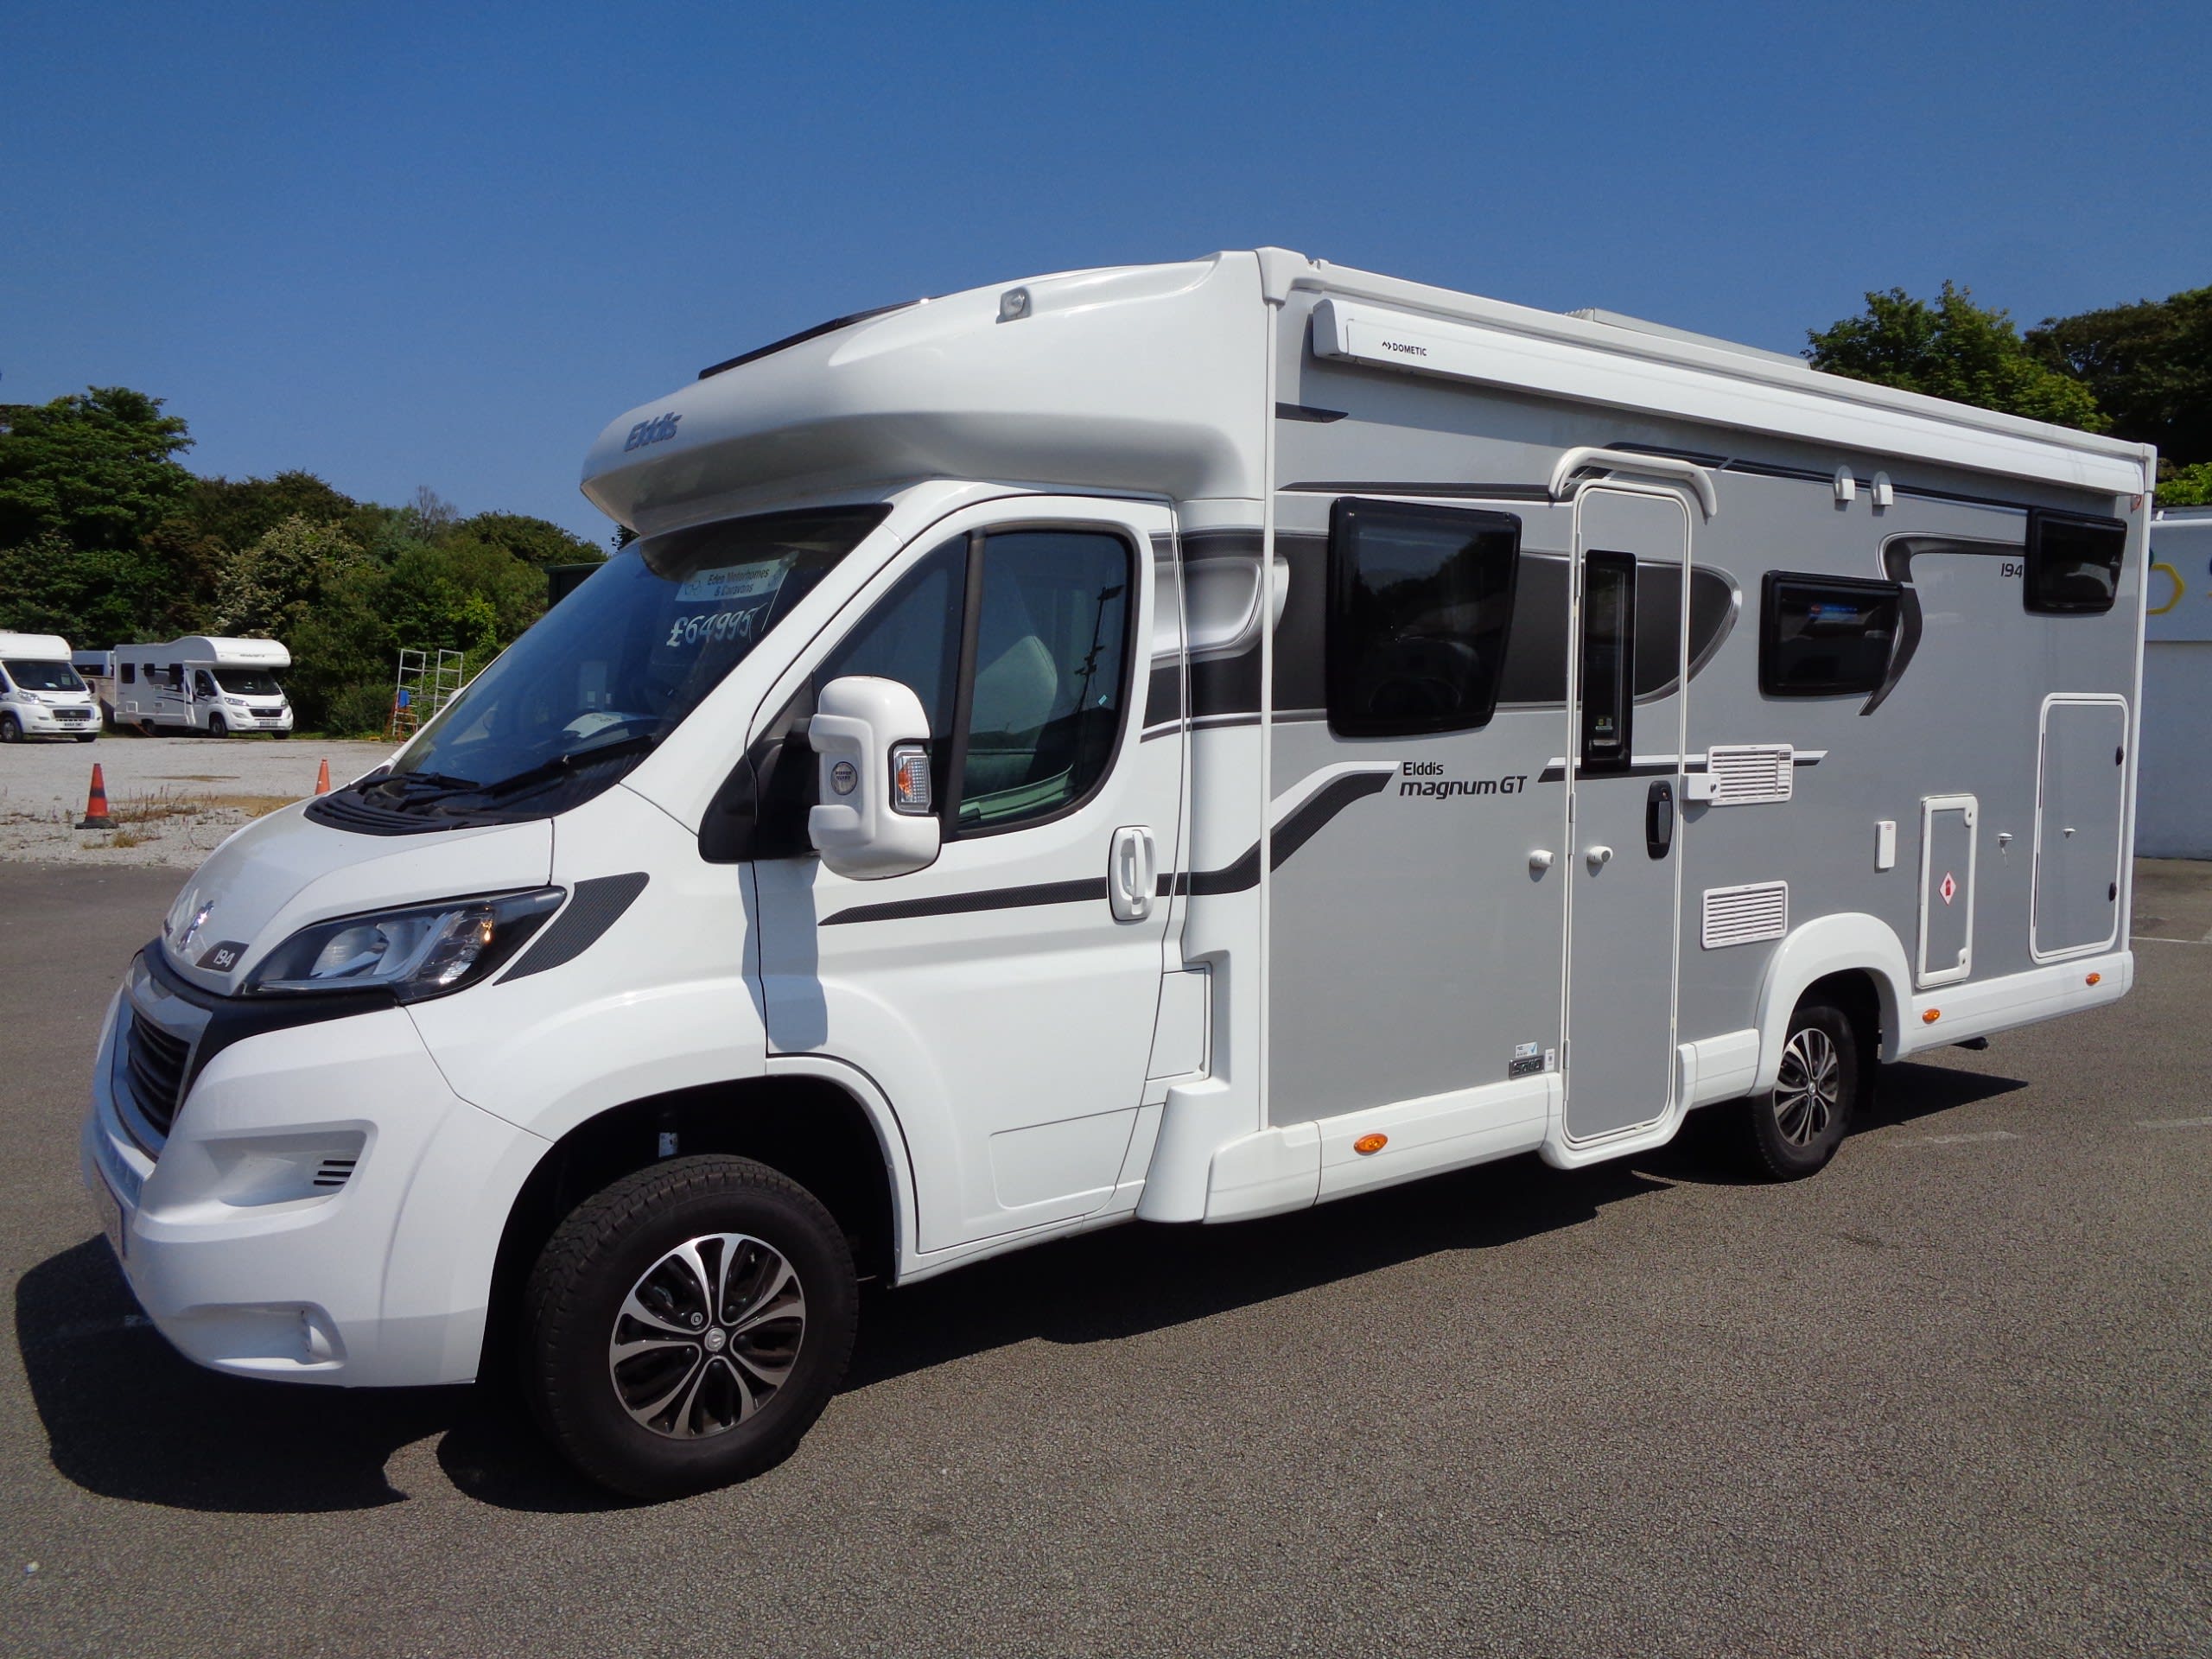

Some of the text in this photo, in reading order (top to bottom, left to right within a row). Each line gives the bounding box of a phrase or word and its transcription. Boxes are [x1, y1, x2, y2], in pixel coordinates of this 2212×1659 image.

[1392, 342, 1427, 356] DOMETIC
[707, 569, 770, 586] Eden Motorhomes
[2000, 563, 2024, 579] 194
[1402, 761, 1445, 776] Elddis
[1399, 775, 1528, 800] magnum GT
[213, 949, 236, 968] 194
